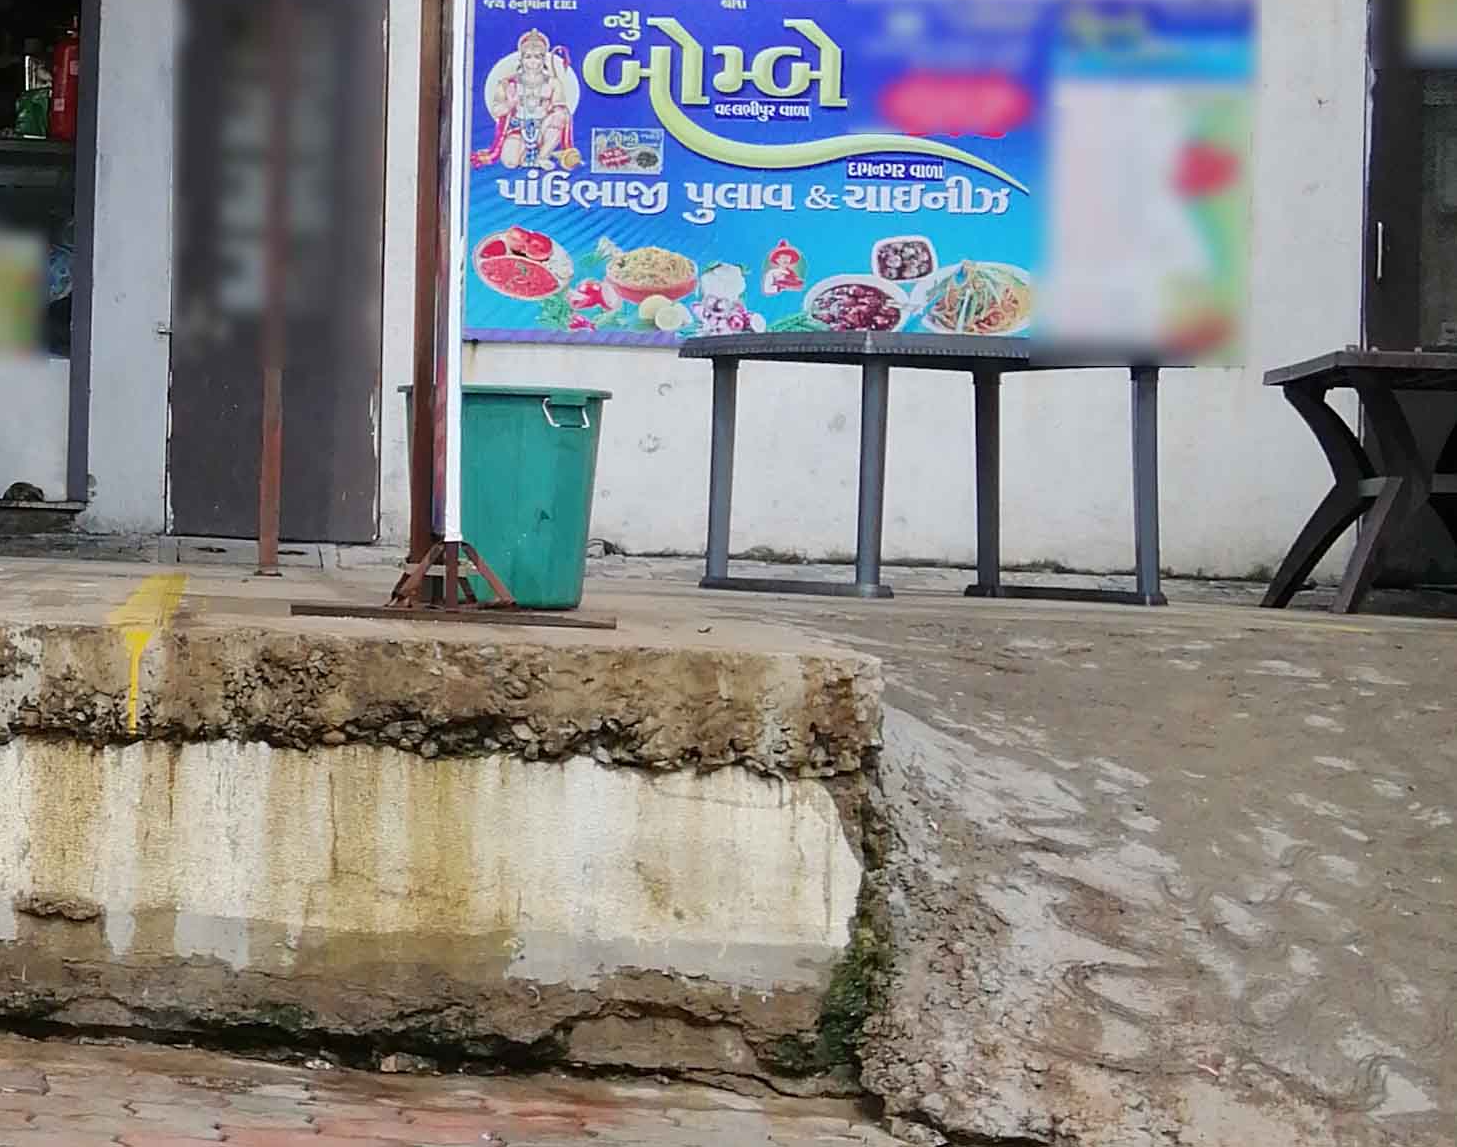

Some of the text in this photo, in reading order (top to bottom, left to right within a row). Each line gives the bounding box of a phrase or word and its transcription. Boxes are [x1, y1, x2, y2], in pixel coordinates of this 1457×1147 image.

[603, 10, 642, 41] ન્યુ
[583, 17, 848, 108] બોમ્બે
[496, 169, 669, 214] પાંઉભાજી
[682, 182, 796, 224] પુલાવ
[804, 184, 841, 210] &
